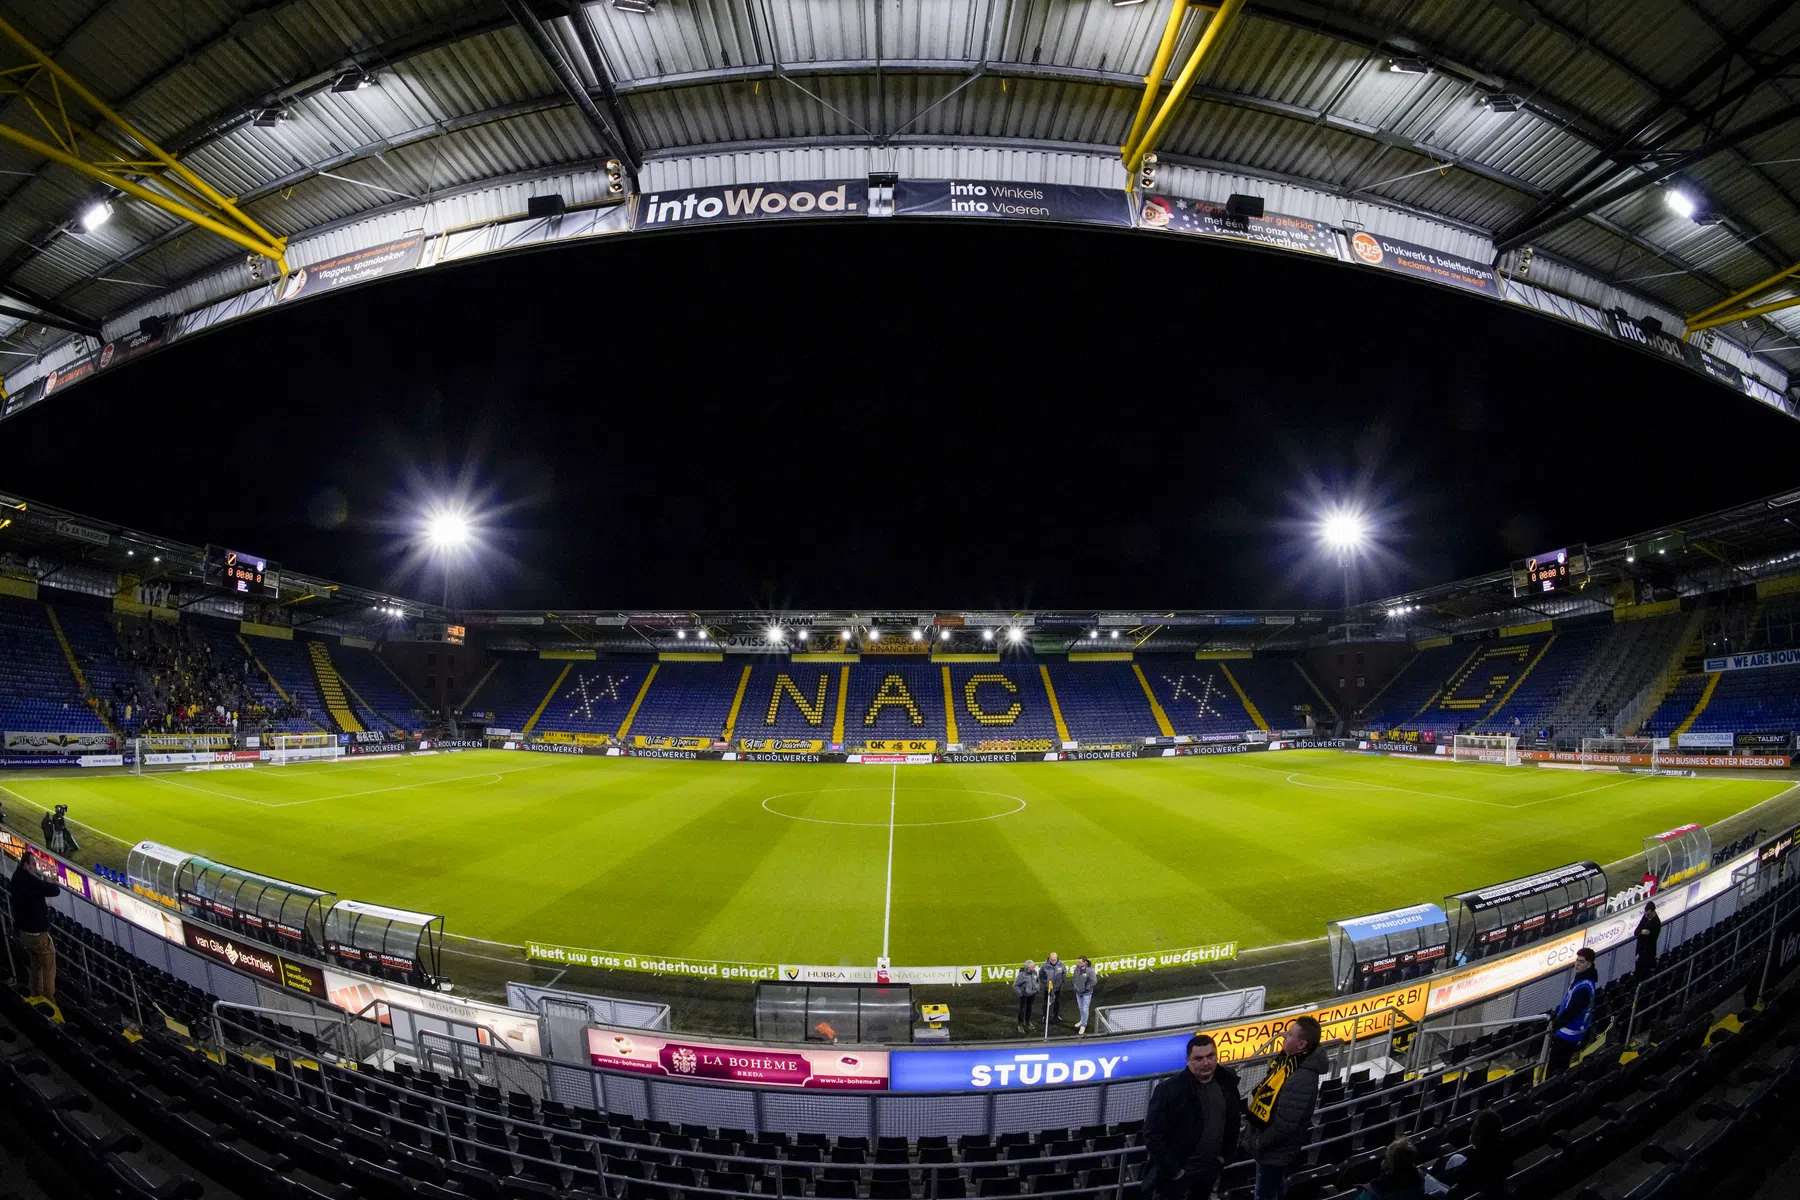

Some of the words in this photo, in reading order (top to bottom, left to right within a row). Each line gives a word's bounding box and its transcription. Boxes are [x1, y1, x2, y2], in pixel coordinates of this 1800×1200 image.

[950, 182, 986, 197] into
[990, 185, 1043, 200] Winkels
[646, 184, 857, 224] intoWood.
[951, 198, 988, 213] into
[992, 202, 1050, 216] Vloeren
[1204, 215, 1223, 226] met
[1246, 224, 1264, 234] van
[1266, 227, 1288, 238] onze
[1289, 230, 1309, 241] vele
[1275, 214, 1317, 233] gelukkig.
[1382, 242, 1427, 262] Drukwerk
[1428, 254, 1436, 264] &
[353, 250, 405, 271] spandoeken
[1397, 257, 1432, 273] Reclame
[780, 617, 813, 625] SAMAN
[1733, 656, 1749, 669] WE
[1750, 653, 1770, 668] ARE
[1678, 733, 1733, 742] FINANCIERINGSGILDE
[1738, 735, 1785, 743] WERKTALENT.
[531, 744, 584, 754] RIOOLWERKEN
[870, 740, 887, 750] OK
[909, 740, 927, 750] OK
[1193, 745, 1247, 755] RIOOLWERKEN
[1378, 742, 1418, 753] RIOOLWERKEN
[214, 751, 236, 762] brefu
[638, 750, 697, 759] RIOOLWERKEN
[756, 752, 820, 762] RIOOLWERKEN
[953, 753, 1017, 762] RIOOLWERKEN
[1078, 750, 1139, 760] RIOOLWERKEN
[1594, 754, 1609, 762] ELKE
[1609, 755, 1632, 763] DIVISIE
[1676, 756, 1709, 766] BUSINESS
[1710, 757, 1738, 766] CENTER
[1739, 758, 1785, 767] NEDERLAND
[1371, 915, 1423, 930] SPANDOEKEN
[194, 936, 209, 948] van
[210, 940, 225, 955] Gils
[239, 951, 275, 974] techniek
[1096, 954, 1156, 977] prettige
[1160, 943, 1234, 966] wedstrijd!
[1547, 943, 1576, 967] ees
[531, 945, 565, 963] Heeft
[568, 952, 588, 965] uw
[590, 955, 620, 970] gras
[624, 955, 638, 968] al
[641, 958, 718, 977] onderhoud
[721, 964, 776, 981] gehad?
[807, 971, 846, 979] HUBRA
[888, 971, 952, 980] ANAGEMENT
[1317, 997, 1393, 1024] FINANCE
[1396, 993, 1406, 1008] &
[1407, 987, 1423, 1004] BI
[1209, 1017, 1300, 1047] ASPARO
[598, 1057, 652, 1069] www.la-boheme.nl
[703, 1054, 723, 1067] LA
[729, 1053, 798, 1072] BOHÈME
[737, 1069, 764, 1079] BREDA
[820, 1077, 881, 1086] www.la-boheme.nl
